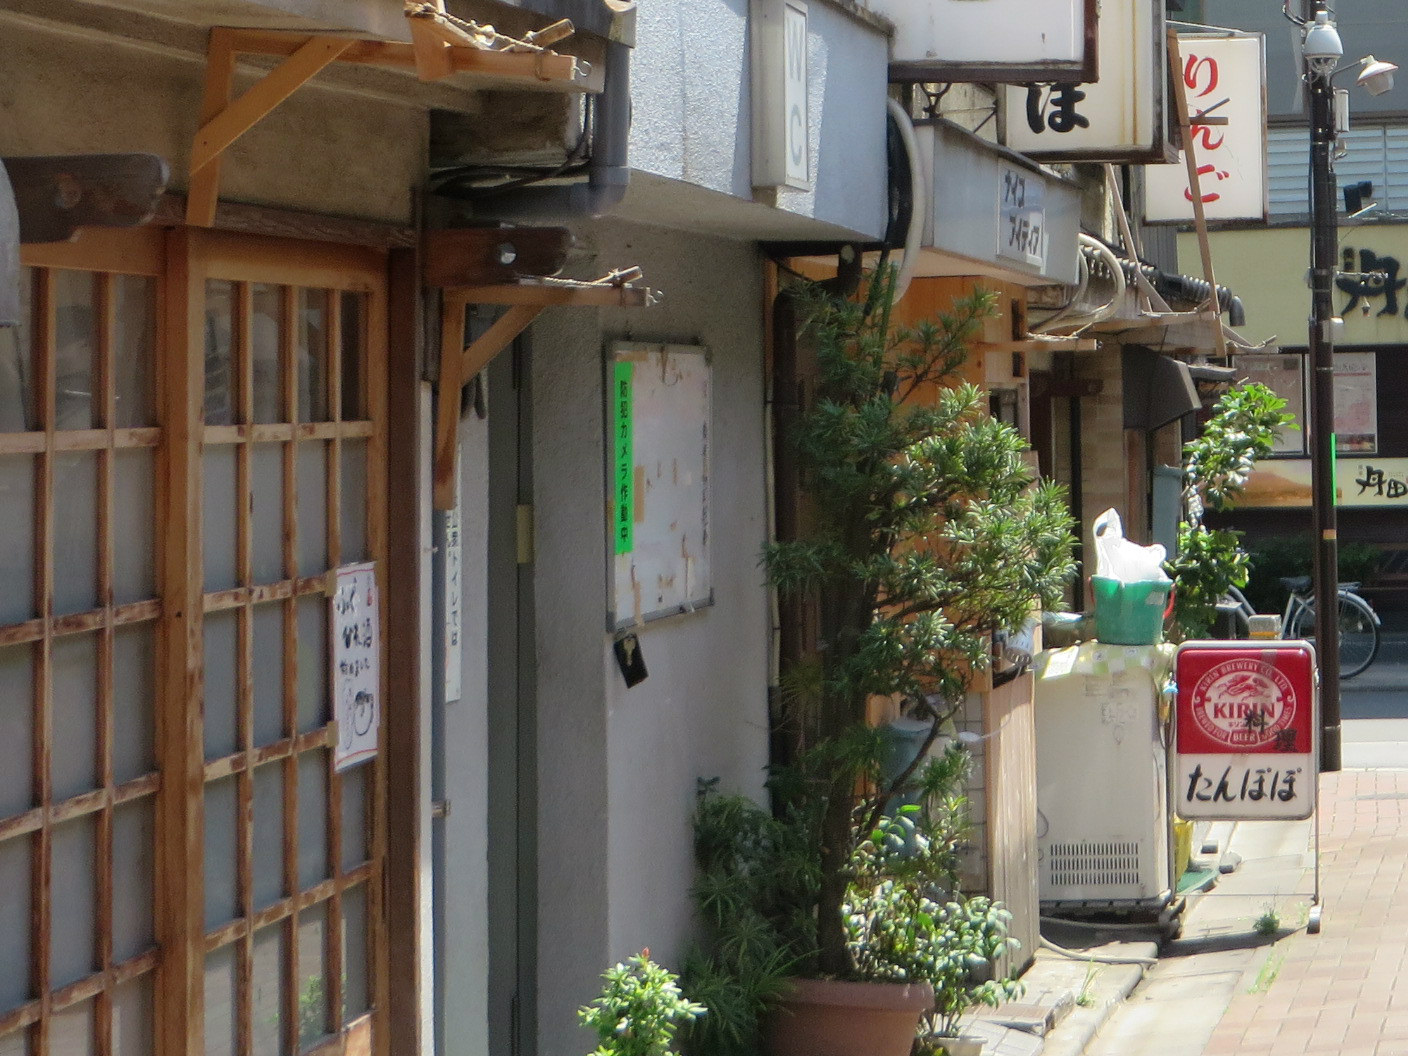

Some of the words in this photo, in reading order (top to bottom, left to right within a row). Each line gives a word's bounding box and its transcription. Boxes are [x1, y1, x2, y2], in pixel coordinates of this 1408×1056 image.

[1183, 53, 1230, 204] りんご
[1213, 701, 1276, 720] KIRIN
[1233, 732, 1256, 743] BEER
[1186, 763, 1303, 803] たんぽぽ
